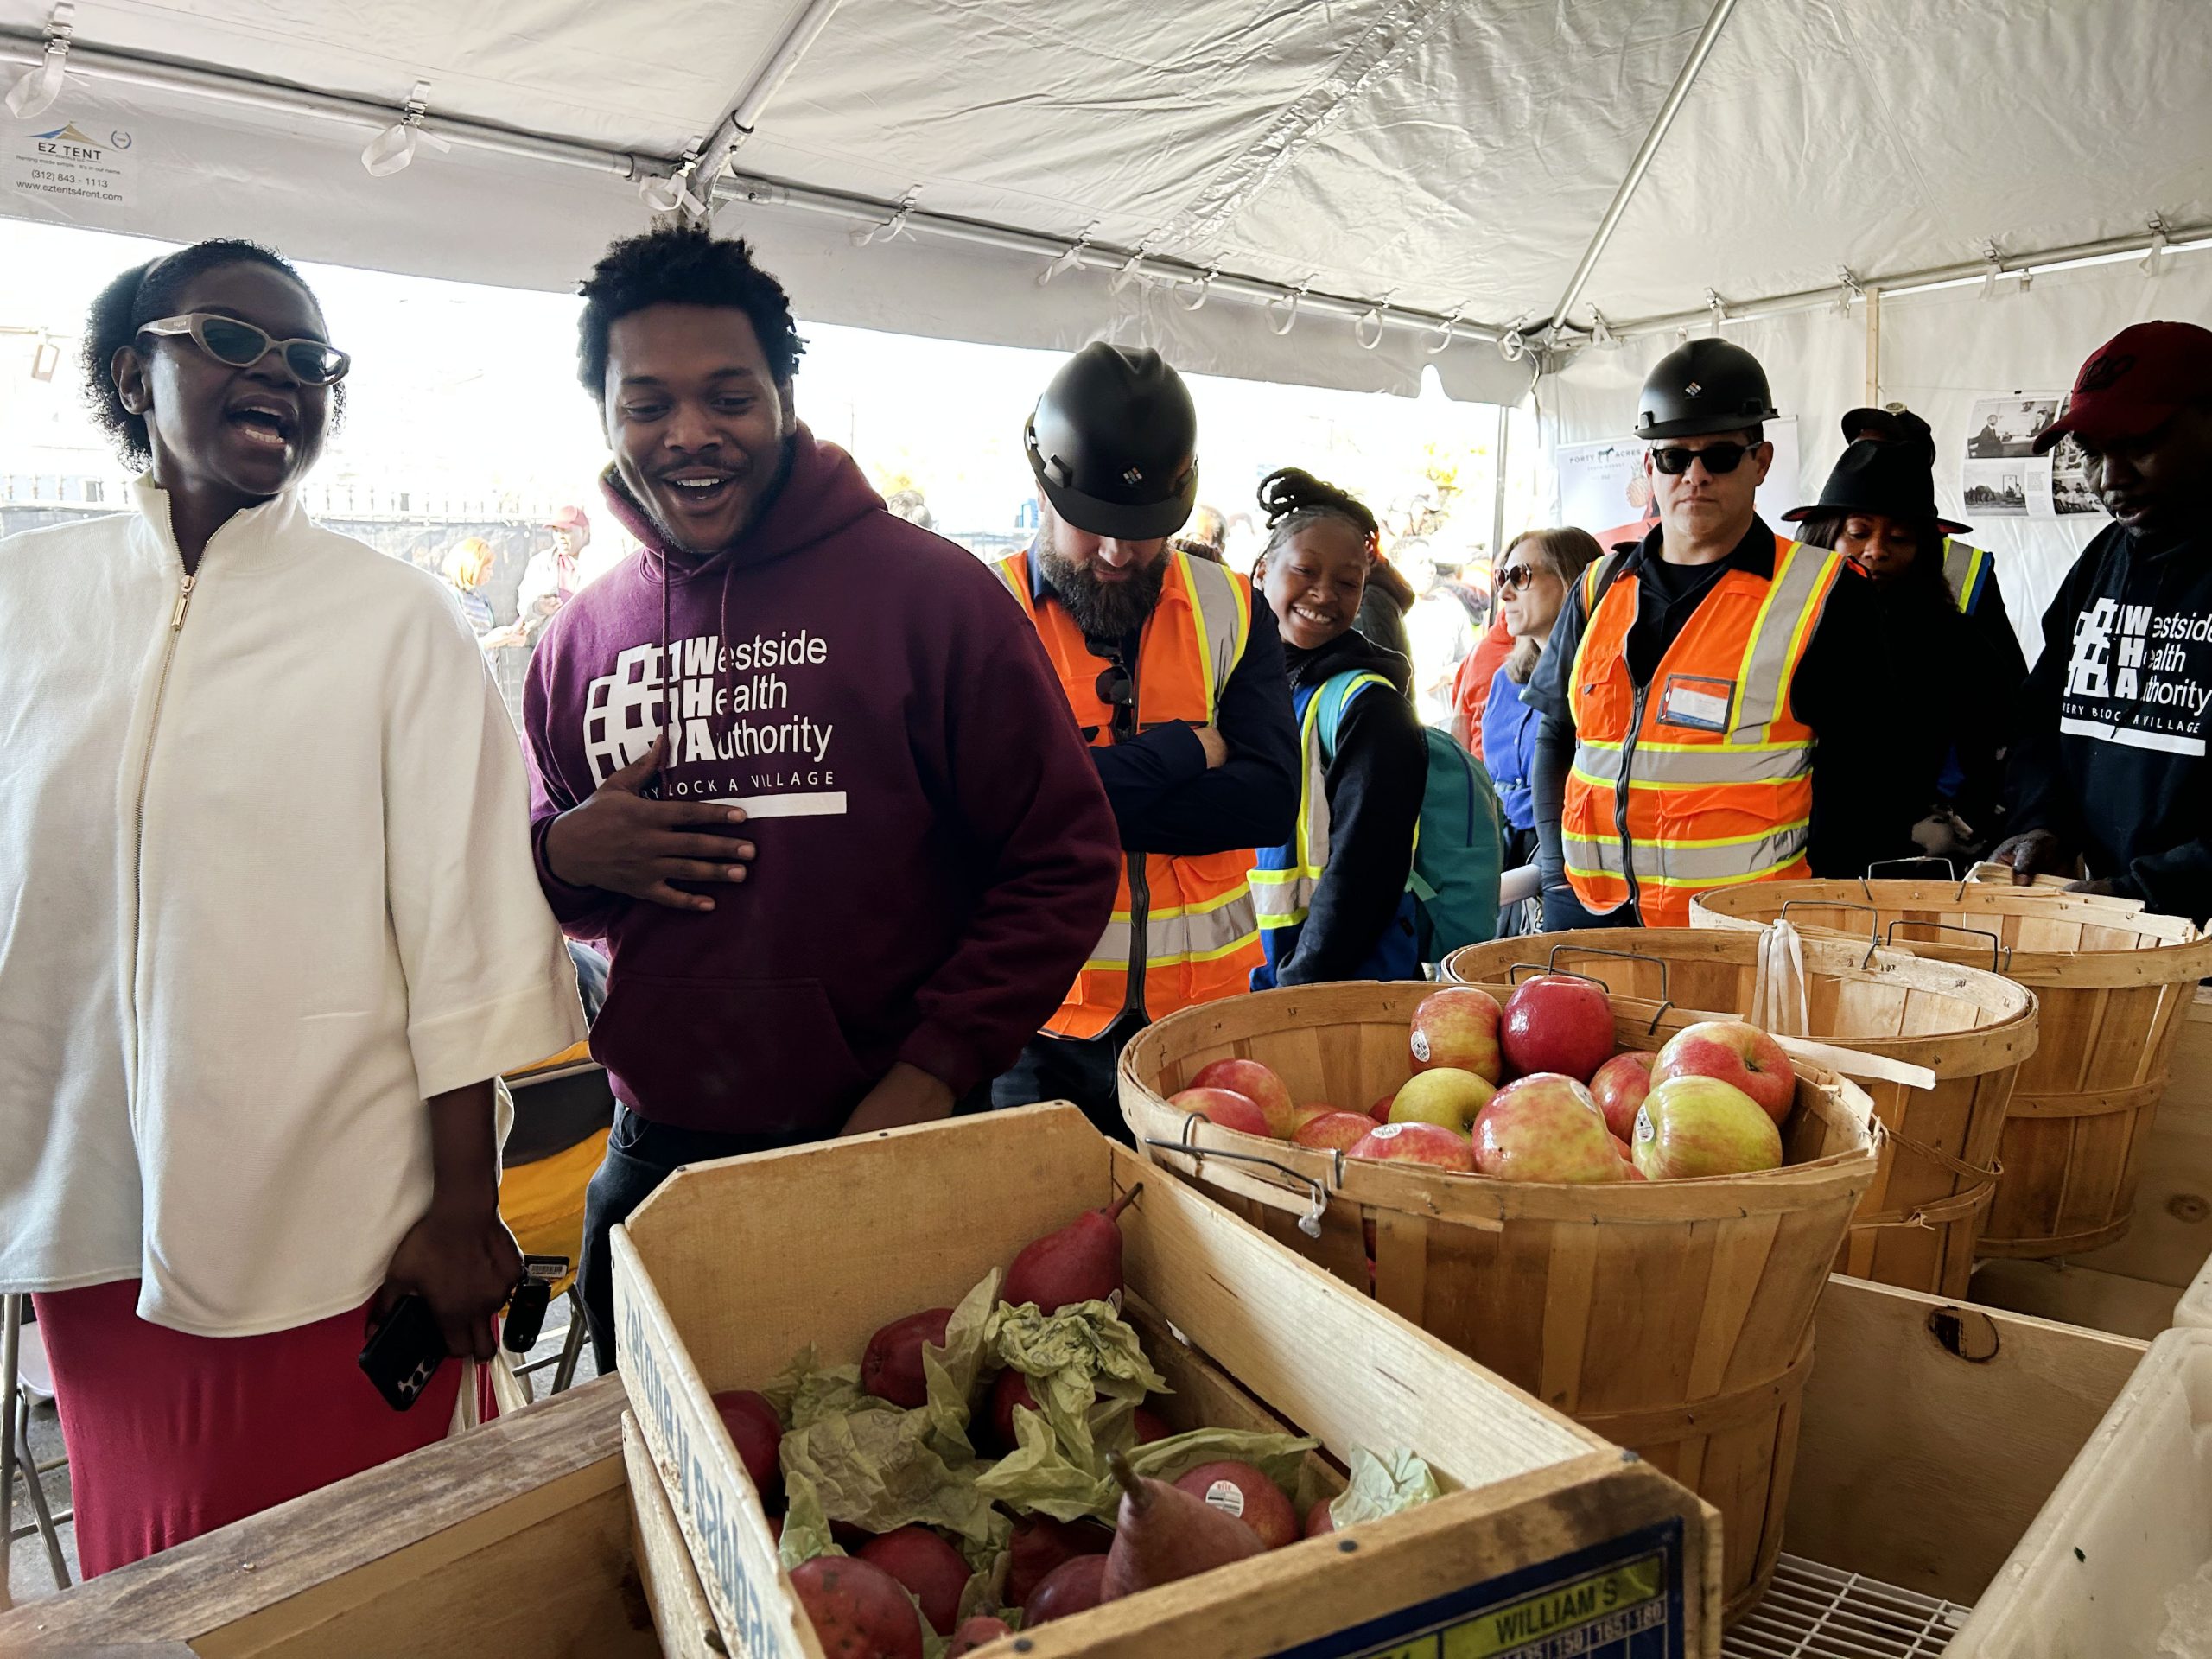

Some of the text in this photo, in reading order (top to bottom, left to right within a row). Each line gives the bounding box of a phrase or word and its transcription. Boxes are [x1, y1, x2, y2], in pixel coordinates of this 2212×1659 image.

[16, 155, 38, 163] Renting
[38, 142, 102, 160] EZ TENT
[31, 169, 55, 181] (312)
[57, 174, 75, 183] 843
[86, 178, 108, 188] 1113
[16, 180, 123, 201] www.eztents4rent.com
[1569, 448, 1642, 464] FORTY ACRES
[684, 629, 828, 677] Westside
[683, 672, 788, 719] Health
[2062, 702, 2085, 715] ERY
[2092, 707, 2122, 721] BLOC
[2143, 715, 2201, 734] VILLAGE
[685, 714, 833, 763] Authority
[668, 779, 718, 797] LOCK
[728, 779, 739, 792] A
[751, 771, 834, 787] VILLAGE
